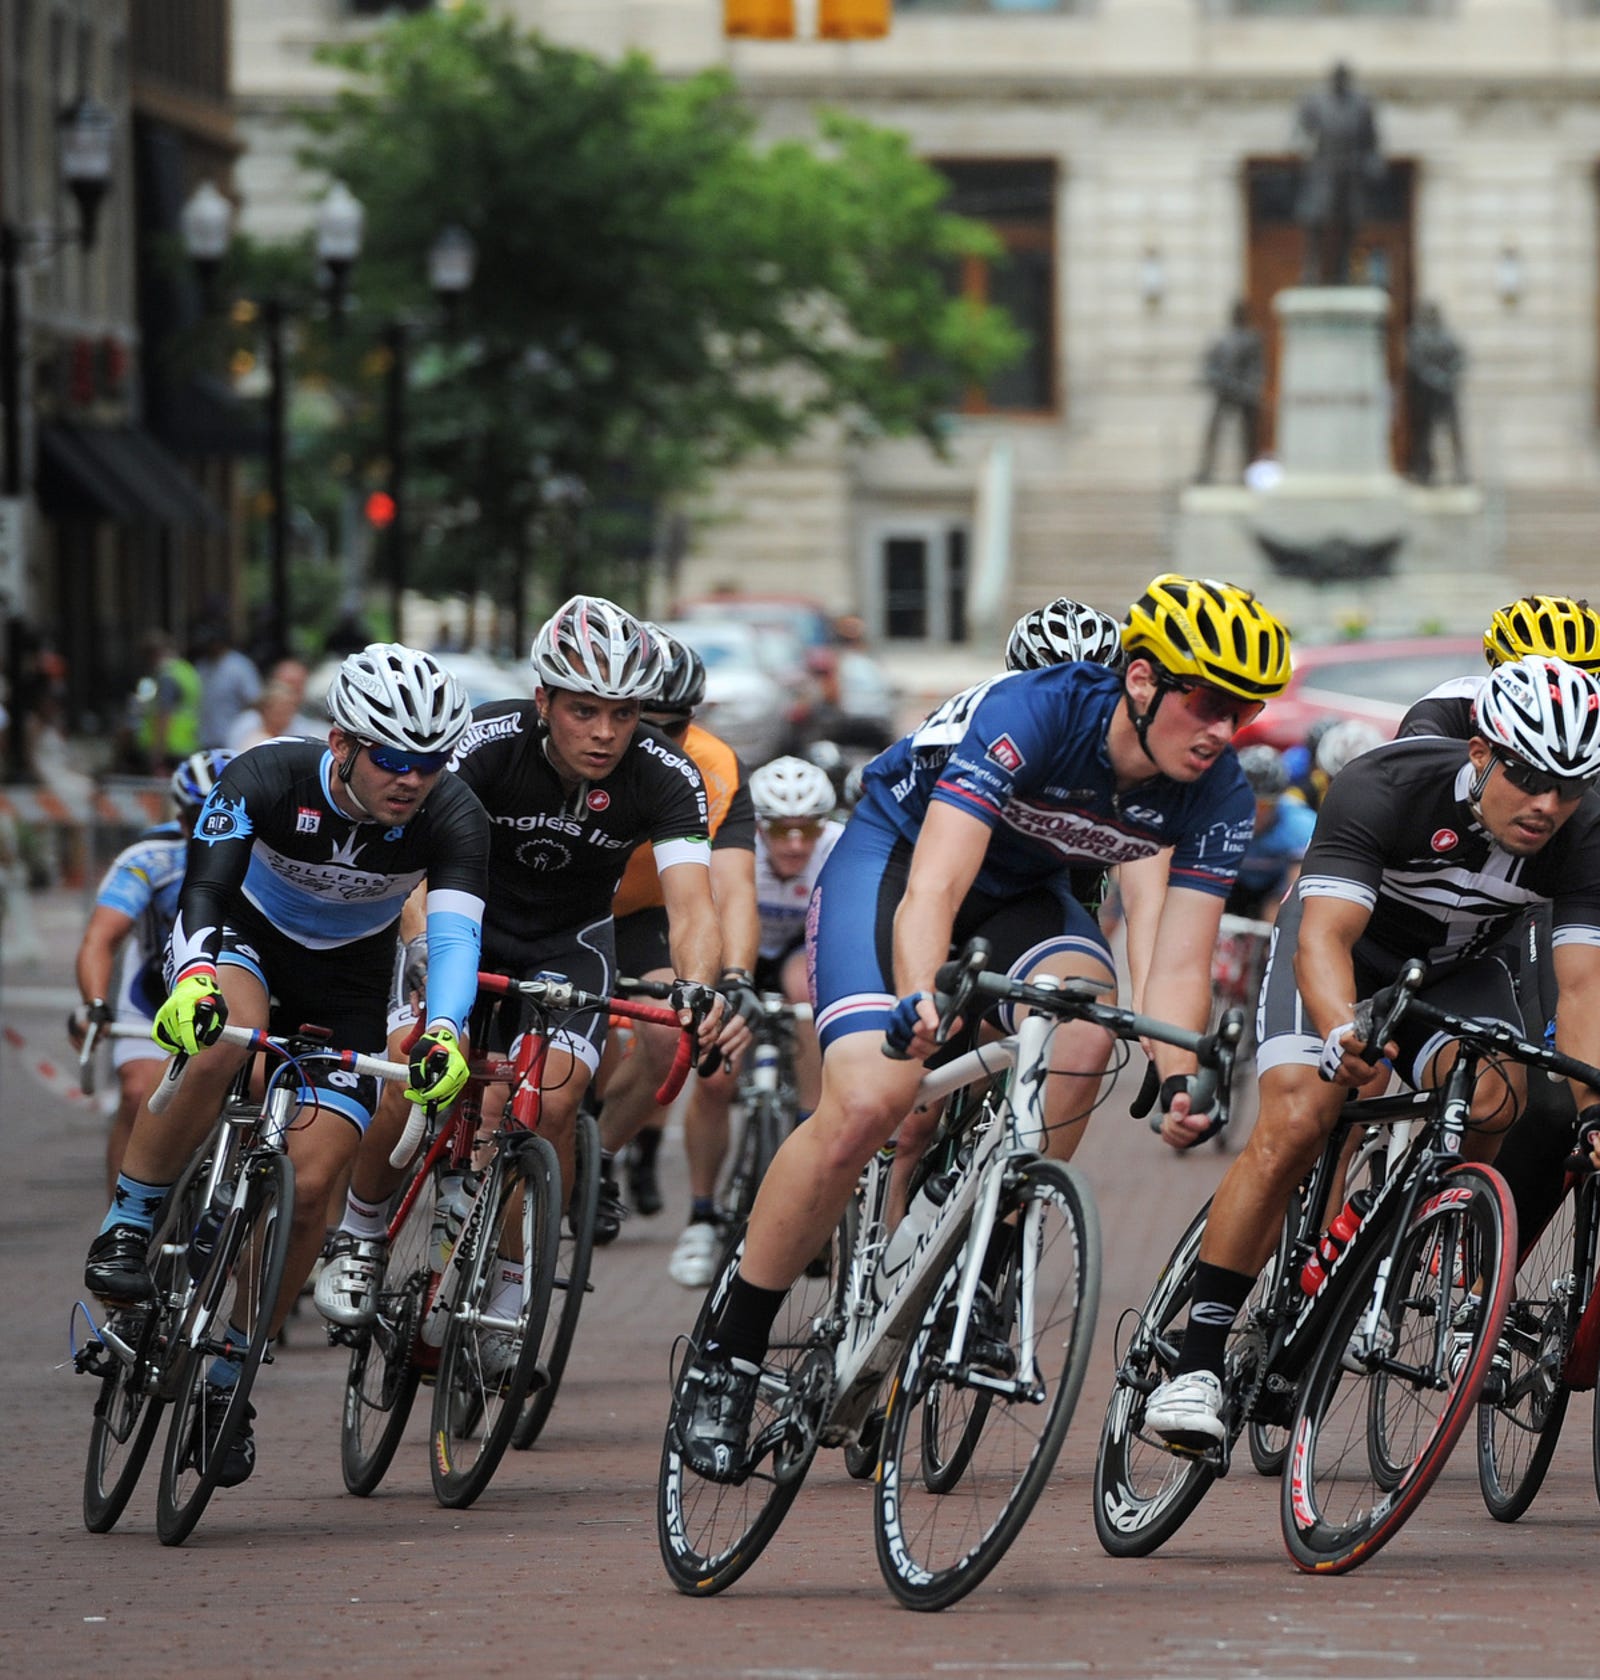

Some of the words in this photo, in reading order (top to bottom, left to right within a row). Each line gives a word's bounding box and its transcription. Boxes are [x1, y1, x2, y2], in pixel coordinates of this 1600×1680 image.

[695, 791, 708, 824] list
[298, 817, 316, 832] 13
[883, 1460, 934, 1586] EASTON
